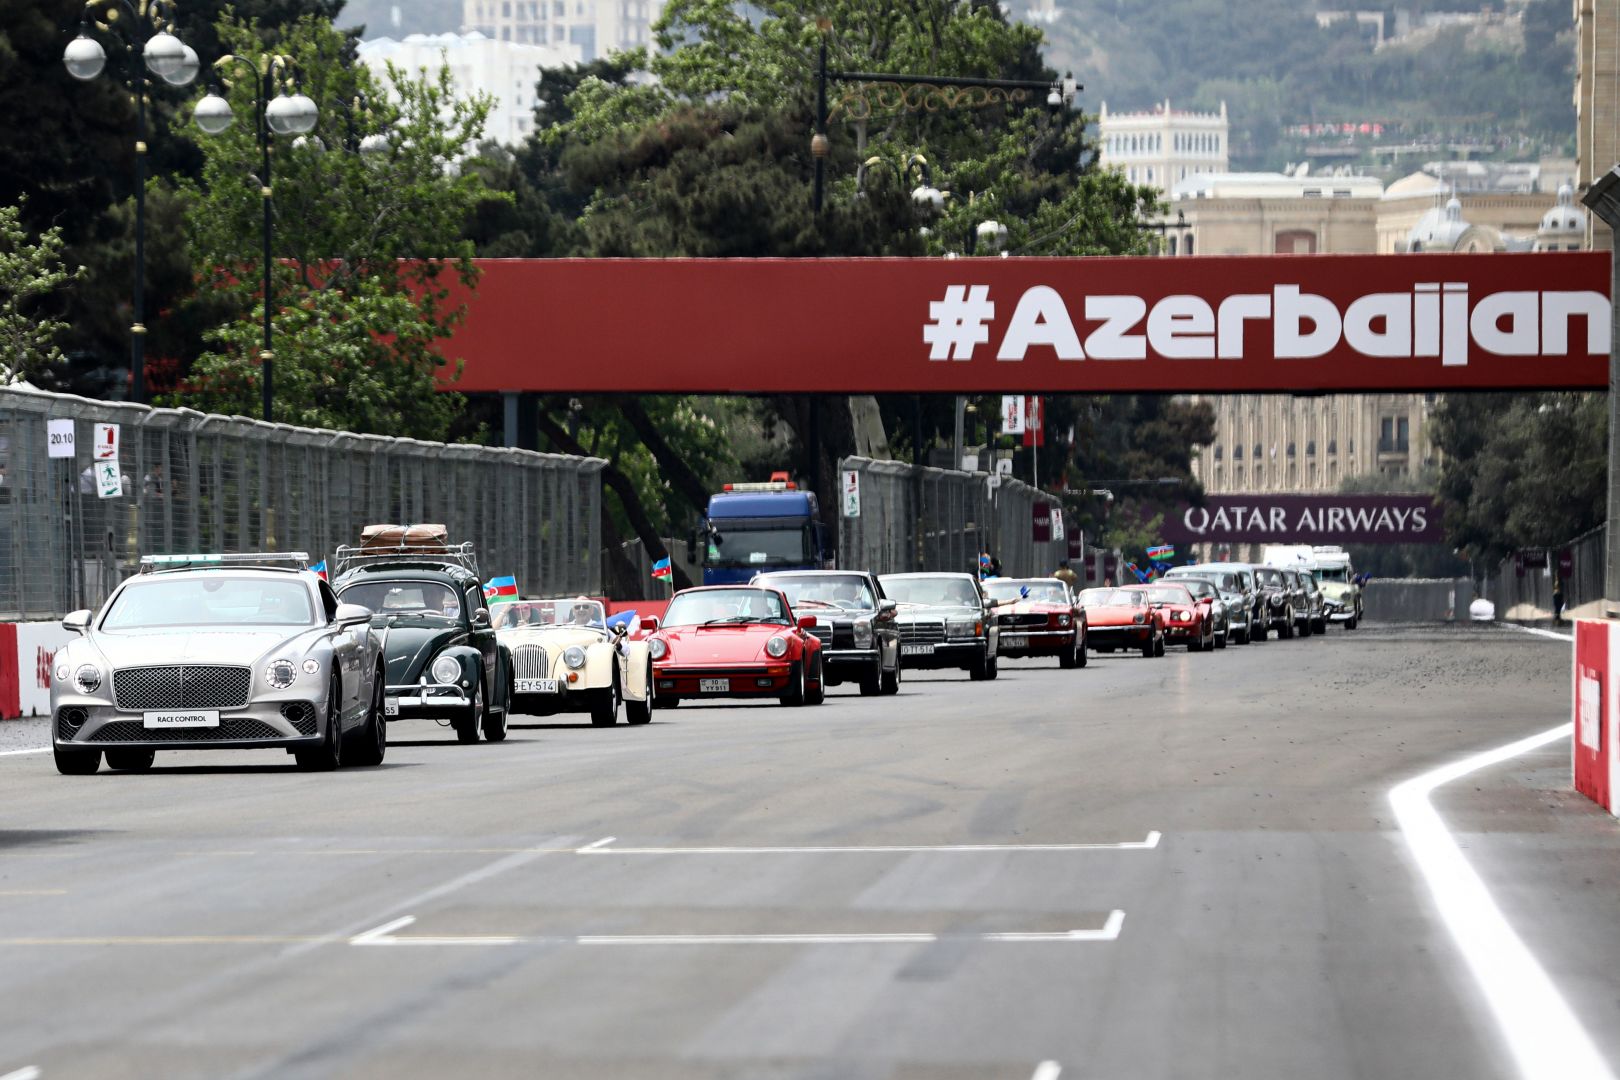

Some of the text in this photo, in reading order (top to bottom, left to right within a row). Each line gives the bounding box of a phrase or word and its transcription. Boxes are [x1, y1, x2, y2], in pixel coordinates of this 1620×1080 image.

[922, 281, 1612, 366] #Azerbaijan
[51, 432, 74, 445] 20.10
[1183, 506, 1427, 534] QATAR AIRWAYS
[175, 715, 207, 723] CONTROL
